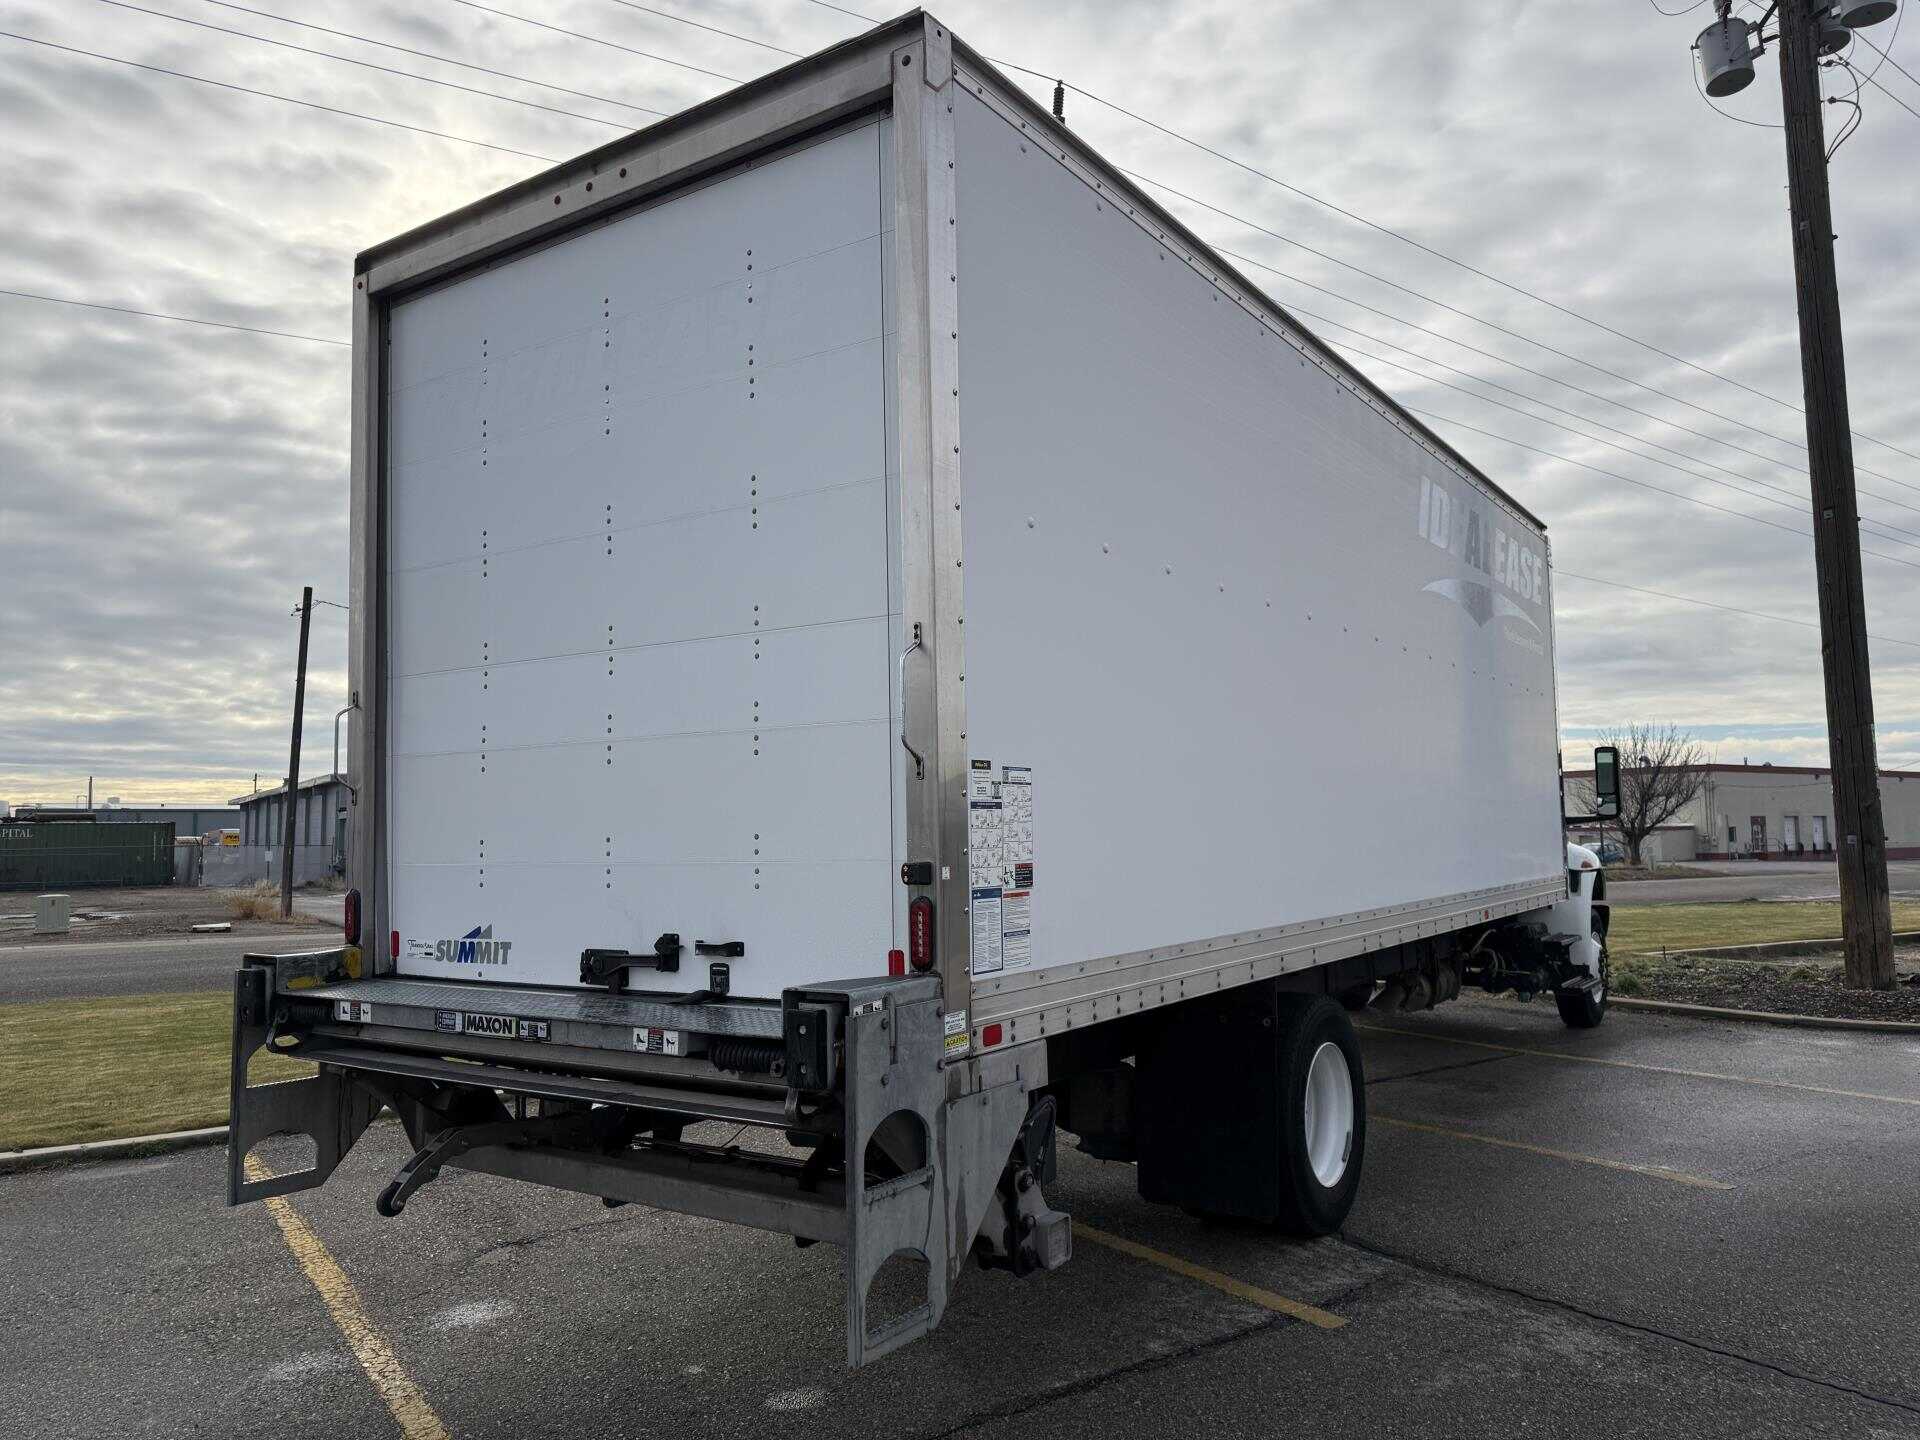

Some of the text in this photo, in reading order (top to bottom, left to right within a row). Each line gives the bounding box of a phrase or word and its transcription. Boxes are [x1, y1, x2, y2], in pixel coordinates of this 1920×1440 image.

[0, 828, 33, 838] PITAL
[435, 939, 512, 965] SUMMIT
[466, 1014, 513, 1035] MAXON
